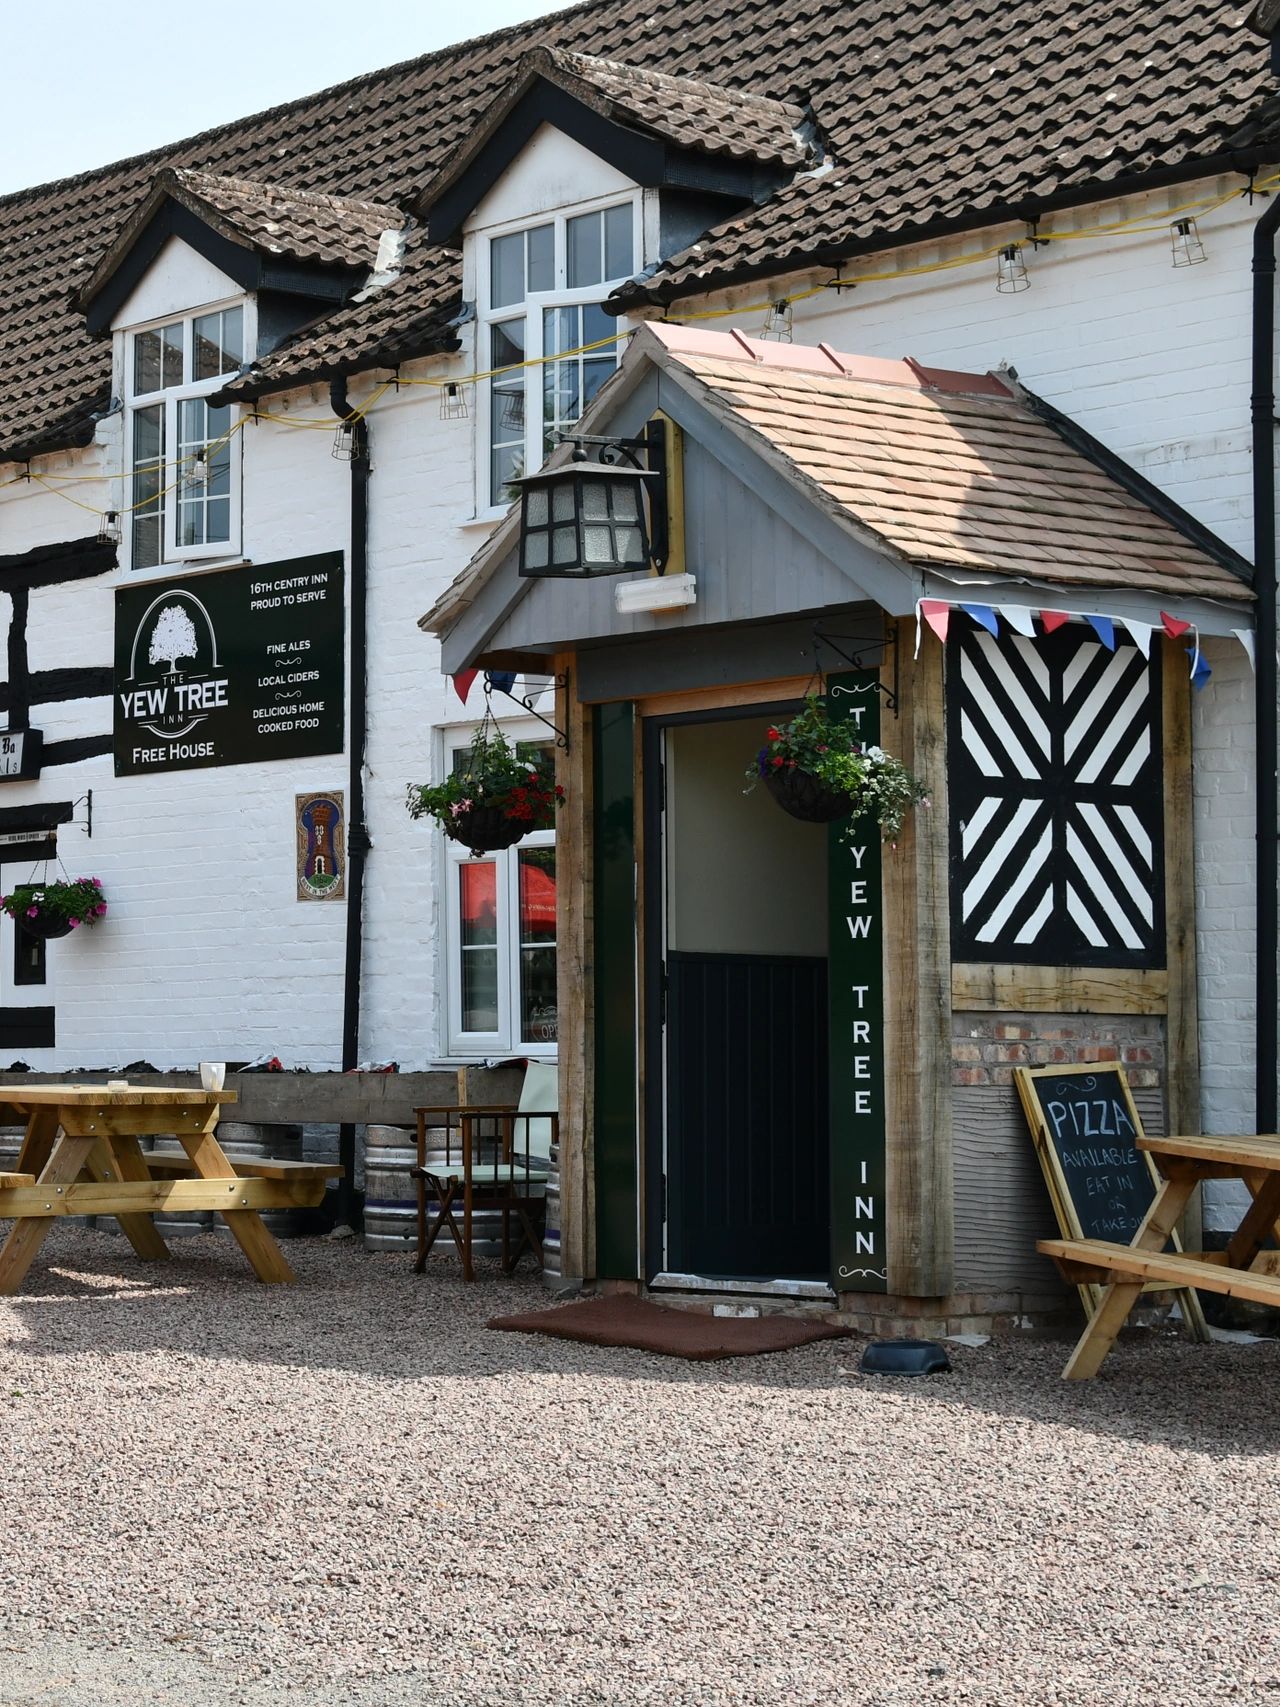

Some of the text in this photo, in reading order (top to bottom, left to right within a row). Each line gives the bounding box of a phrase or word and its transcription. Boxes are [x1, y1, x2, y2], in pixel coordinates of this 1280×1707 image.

[250, 573, 328, 594] 16TH CENTRY INN
[251, 590, 326, 610] PROUD TO SERVE
[267, 640, 310, 654] FINE ALES
[163, 675, 184, 685] THE
[258, 671, 320, 687] LOCAL CIDERS
[121, 680, 229, 718] YEW TREE
[163, 715, 183, 725] INN
[253, 702, 324, 719] DELICIOUS HOME
[258, 718, 319, 734] COOKED FOOD
[133, 742, 214, 763] FREE HOUSE
[846, 846, 876, 1256] YEW TREE INN
[1047, 1100, 1136, 1138] PIZZA
[1062, 1148, 1137, 1167] AVAILABLE
[1086, 1174, 1134, 1196] EAT IN
[1091, 1216, 1127, 1234] TAKE
